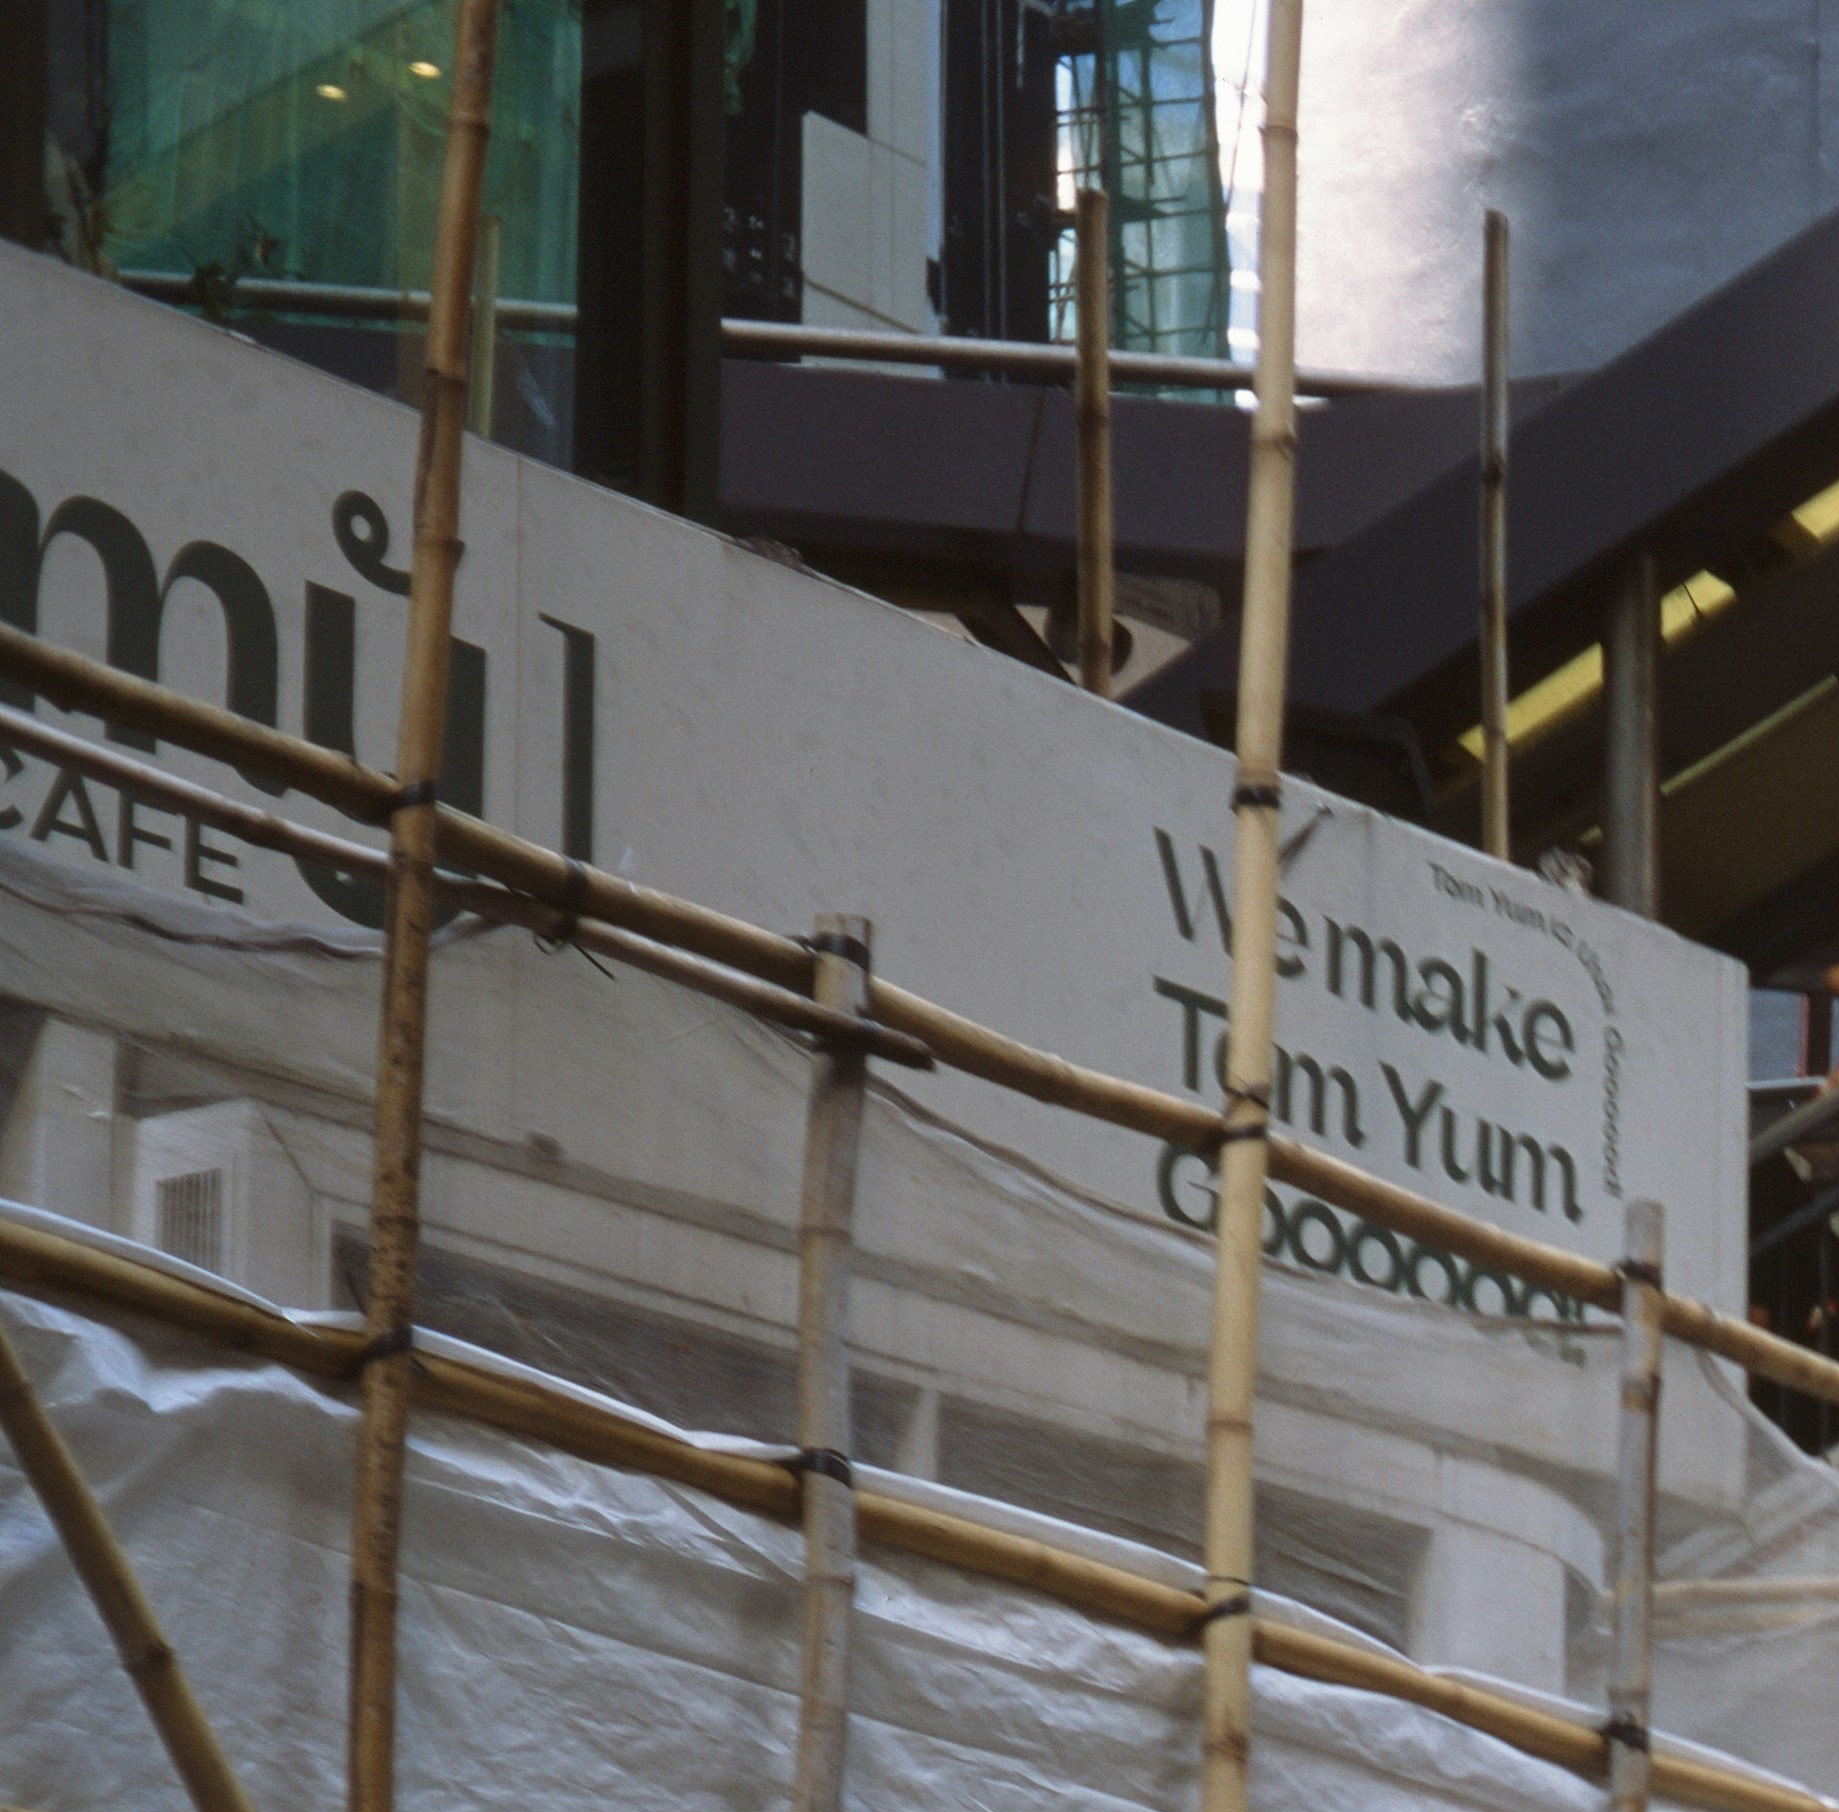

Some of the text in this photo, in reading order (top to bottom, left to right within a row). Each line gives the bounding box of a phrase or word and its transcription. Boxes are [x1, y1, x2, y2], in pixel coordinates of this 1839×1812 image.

[1153, 826, 1310, 979] We
[1322, 914, 1575, 1081] make
[1153, 974, 1584, 1224] Tm Yum
